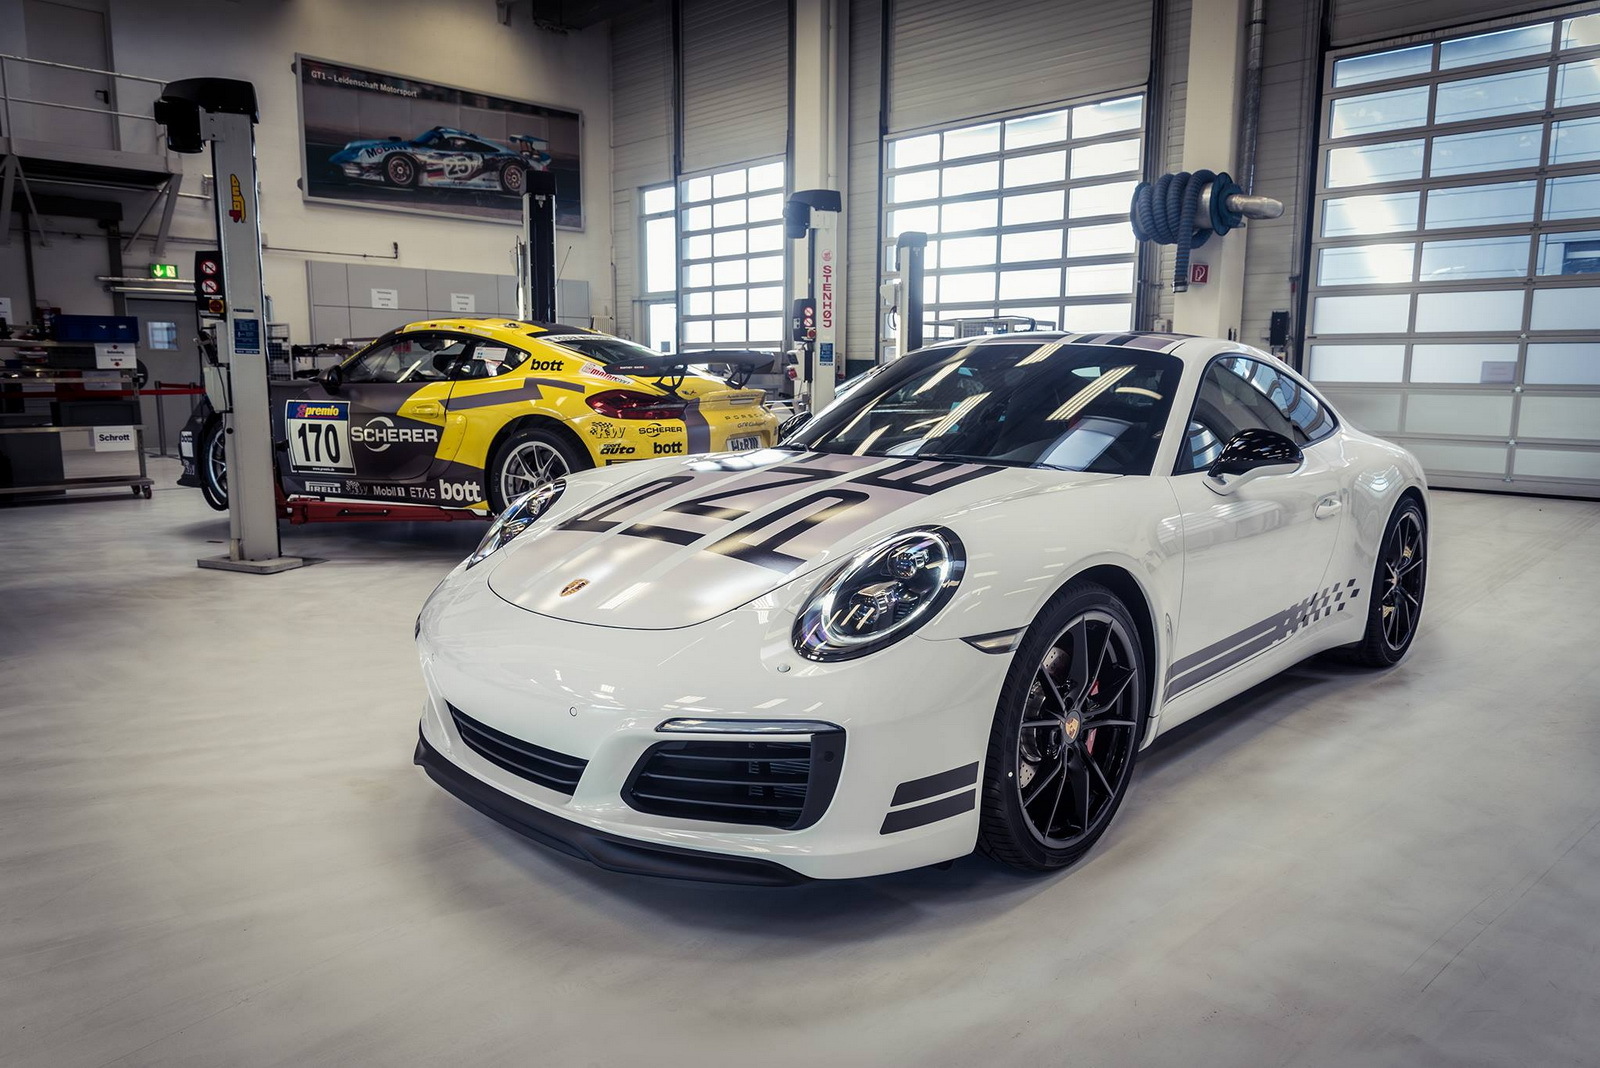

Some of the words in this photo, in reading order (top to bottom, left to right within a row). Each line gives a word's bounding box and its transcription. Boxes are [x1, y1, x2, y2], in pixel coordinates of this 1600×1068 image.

[311, 70, 326, 80] GT1
[333, 74, 379, 91] Leidenschaft
[380, 83, 417, 97] Motorsport
[823, 265, 832, 328] STENHØJ
[530, 358, 564, 371] bott
[305, 405, 339, 418] premio
[350, 426, 438, 442] SCHERER
[638, 426, 682, 435] SCHERER
[99, 434, 130, 442] Schrott
[298, 423, 340, 463] 170
[600, 445, 636, 455] auto
[653, 441, 682, 454] bott
[305, 481, 341, 494] PIRELLI
[373, 485, 396, 496] Mobil
[410, 487, 436, 499] ETAS
[439, 479, 482, 502] bott
